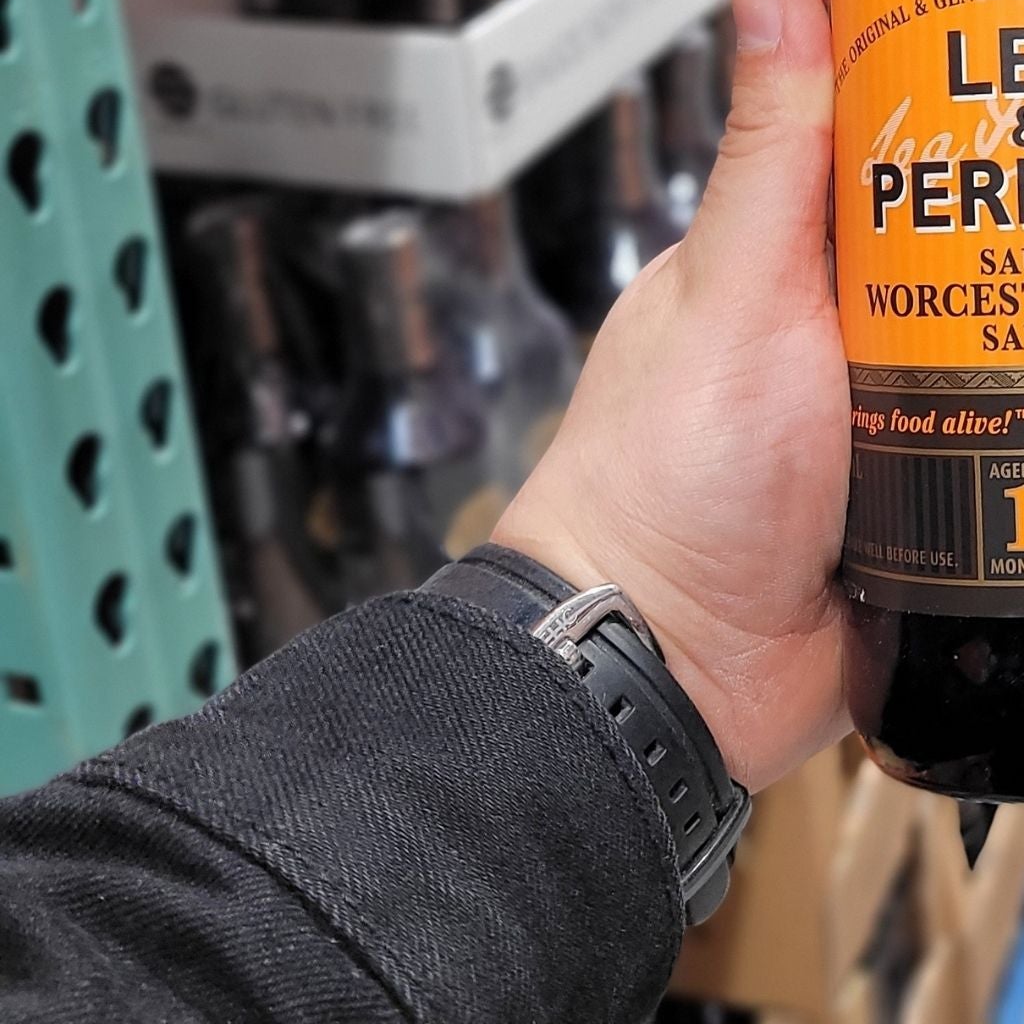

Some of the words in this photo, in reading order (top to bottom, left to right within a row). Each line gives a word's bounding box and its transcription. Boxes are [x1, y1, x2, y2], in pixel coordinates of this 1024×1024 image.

[834, 59, 850, 95] THE
[849, 5, 911, 64] ORIGINAL
[852, 405, 885, 436] rings
[889, 407, 937, 434] food
[886, 545, 926, 566] BEFORE
[930, 551, 959, 569] USE.
